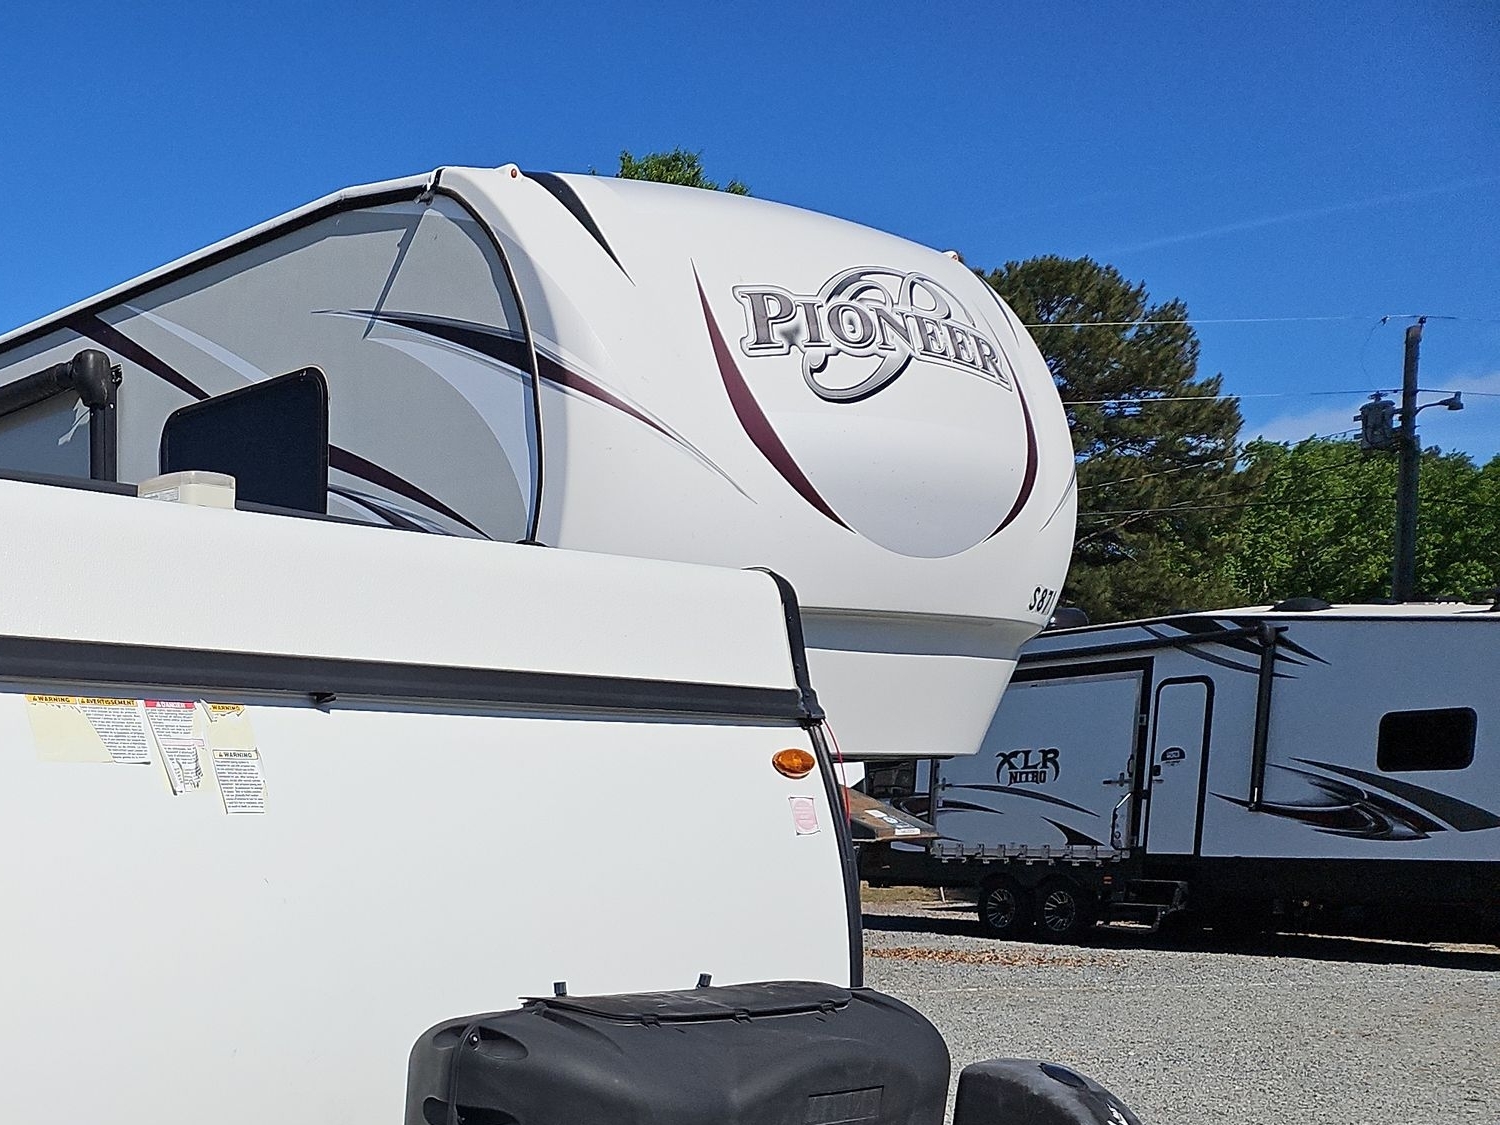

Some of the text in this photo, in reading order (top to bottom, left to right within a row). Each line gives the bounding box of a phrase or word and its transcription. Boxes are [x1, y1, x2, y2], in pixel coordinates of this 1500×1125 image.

[739, 289, 1011, 387] PIONEER
[86, 698, 135, 706] AVERTISSEMENT
[224, 749, 253, 758] WARNING
[995, 748, 1060, 784] XLR
[1007, 770, 1047, 786] NITRO
